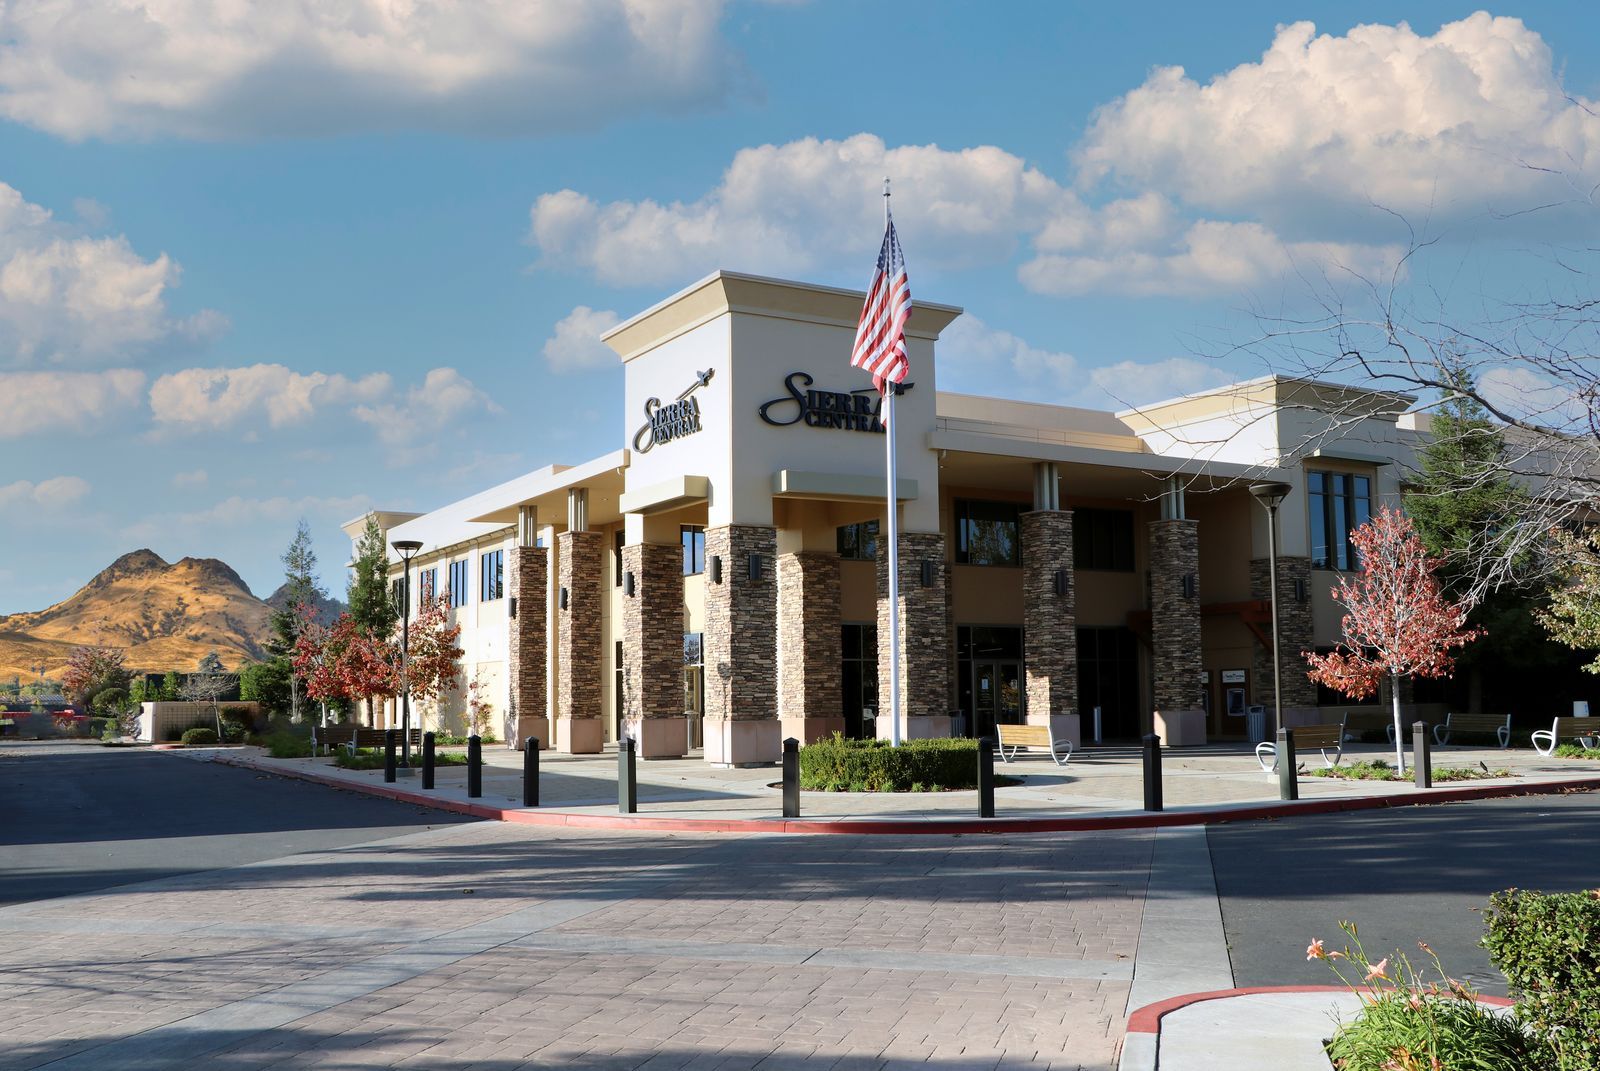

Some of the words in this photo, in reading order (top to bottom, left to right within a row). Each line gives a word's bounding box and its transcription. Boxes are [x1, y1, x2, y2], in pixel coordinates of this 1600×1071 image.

[632, 395, 701, 454] SIERRA
[652, 414, 703, 446] CENTRAL
[804, 410, 887, 433] CENTRA
